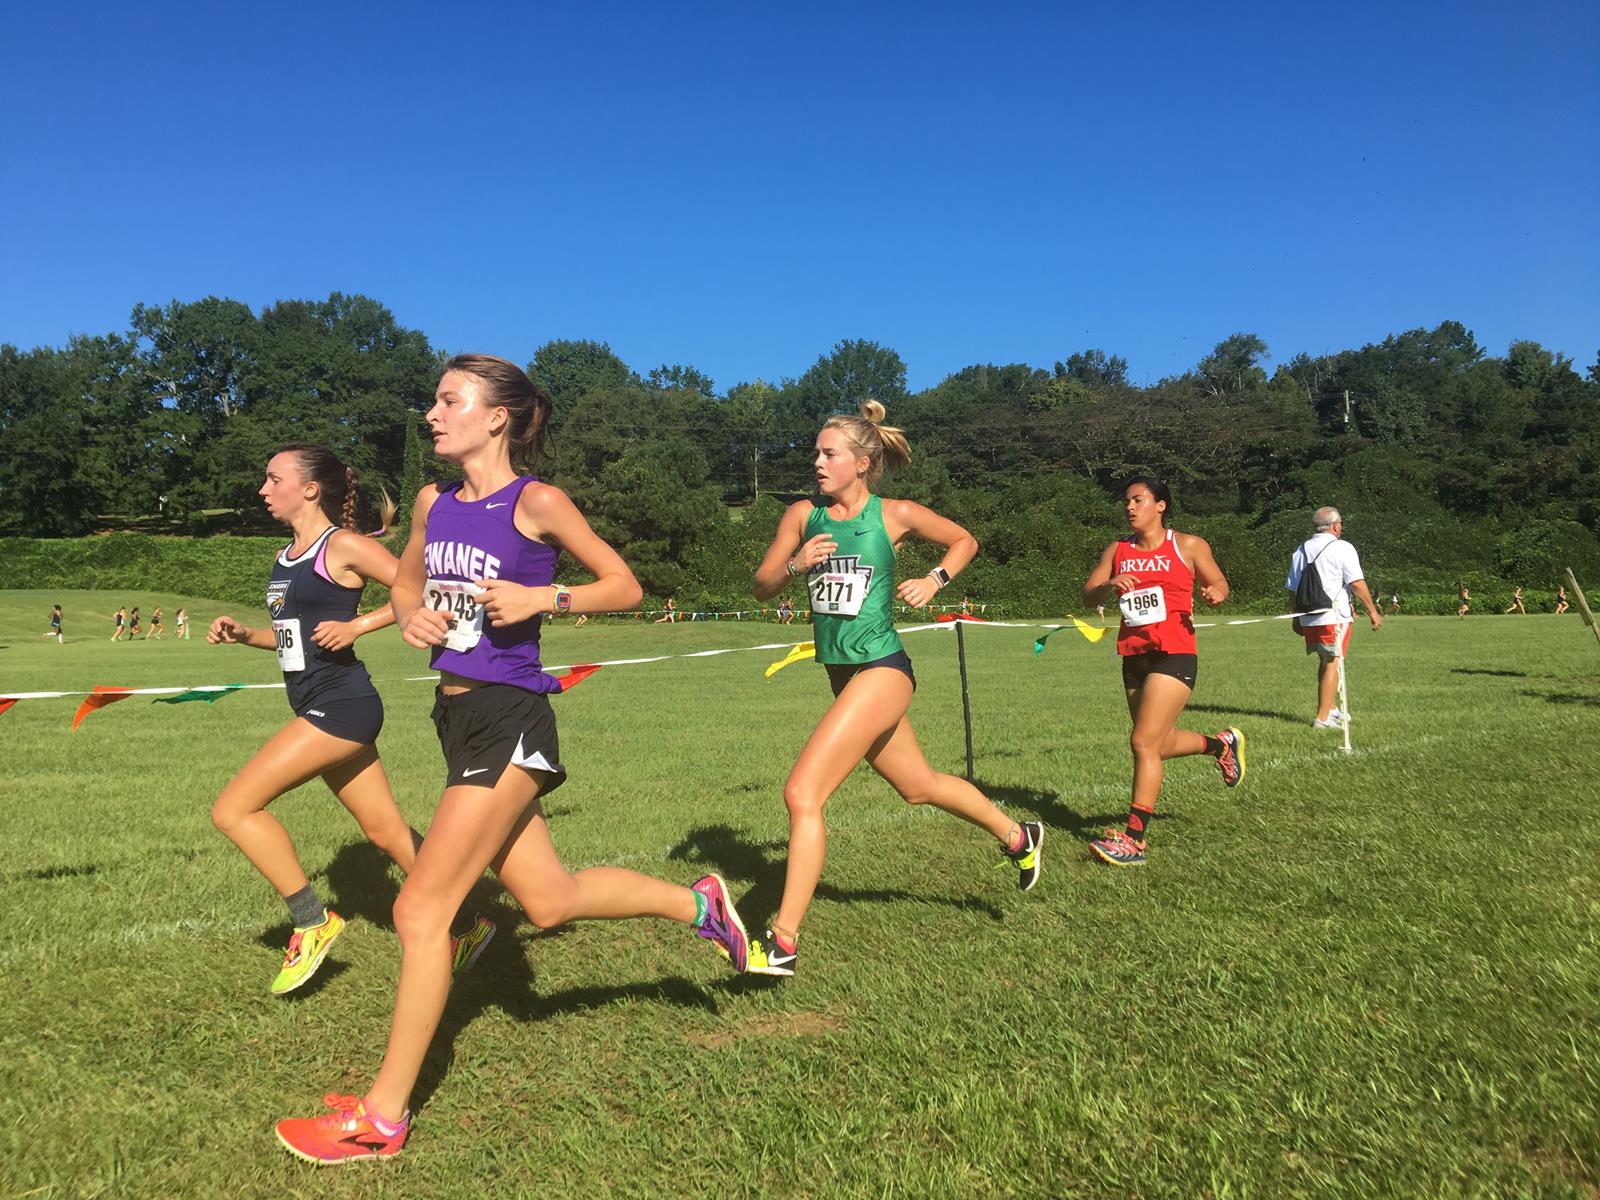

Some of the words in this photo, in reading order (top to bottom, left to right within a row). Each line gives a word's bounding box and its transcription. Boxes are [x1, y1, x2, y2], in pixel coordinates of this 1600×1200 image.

[1120, 558, 1170, 573] BRYAN
[816, 581, 853, 603] 2171
[1126, 593, 1158, 611] 1966
